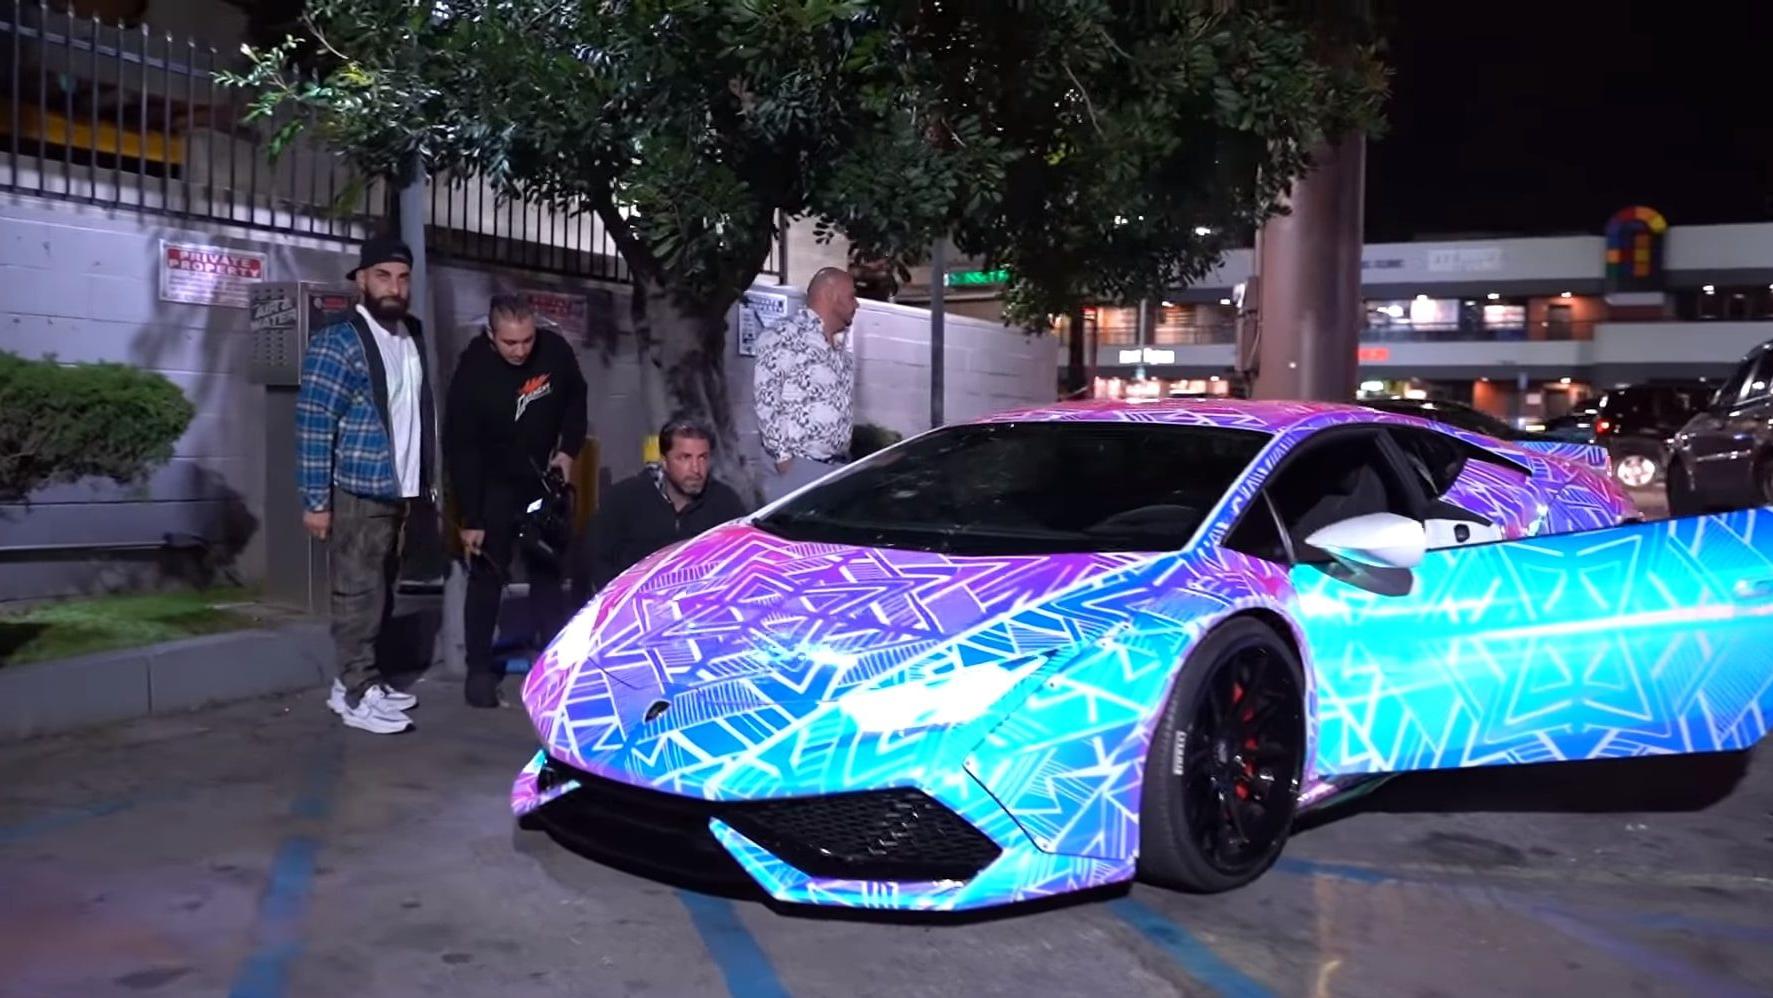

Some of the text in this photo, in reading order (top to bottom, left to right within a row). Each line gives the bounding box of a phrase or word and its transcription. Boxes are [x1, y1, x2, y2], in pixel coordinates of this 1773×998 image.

[169, 259, 261, 278] PROPERTY
[179, 250, 251, 270] PRIVATE
[255, 301, 279, 318] AIR
[250, 309, 297, 330] WATER
